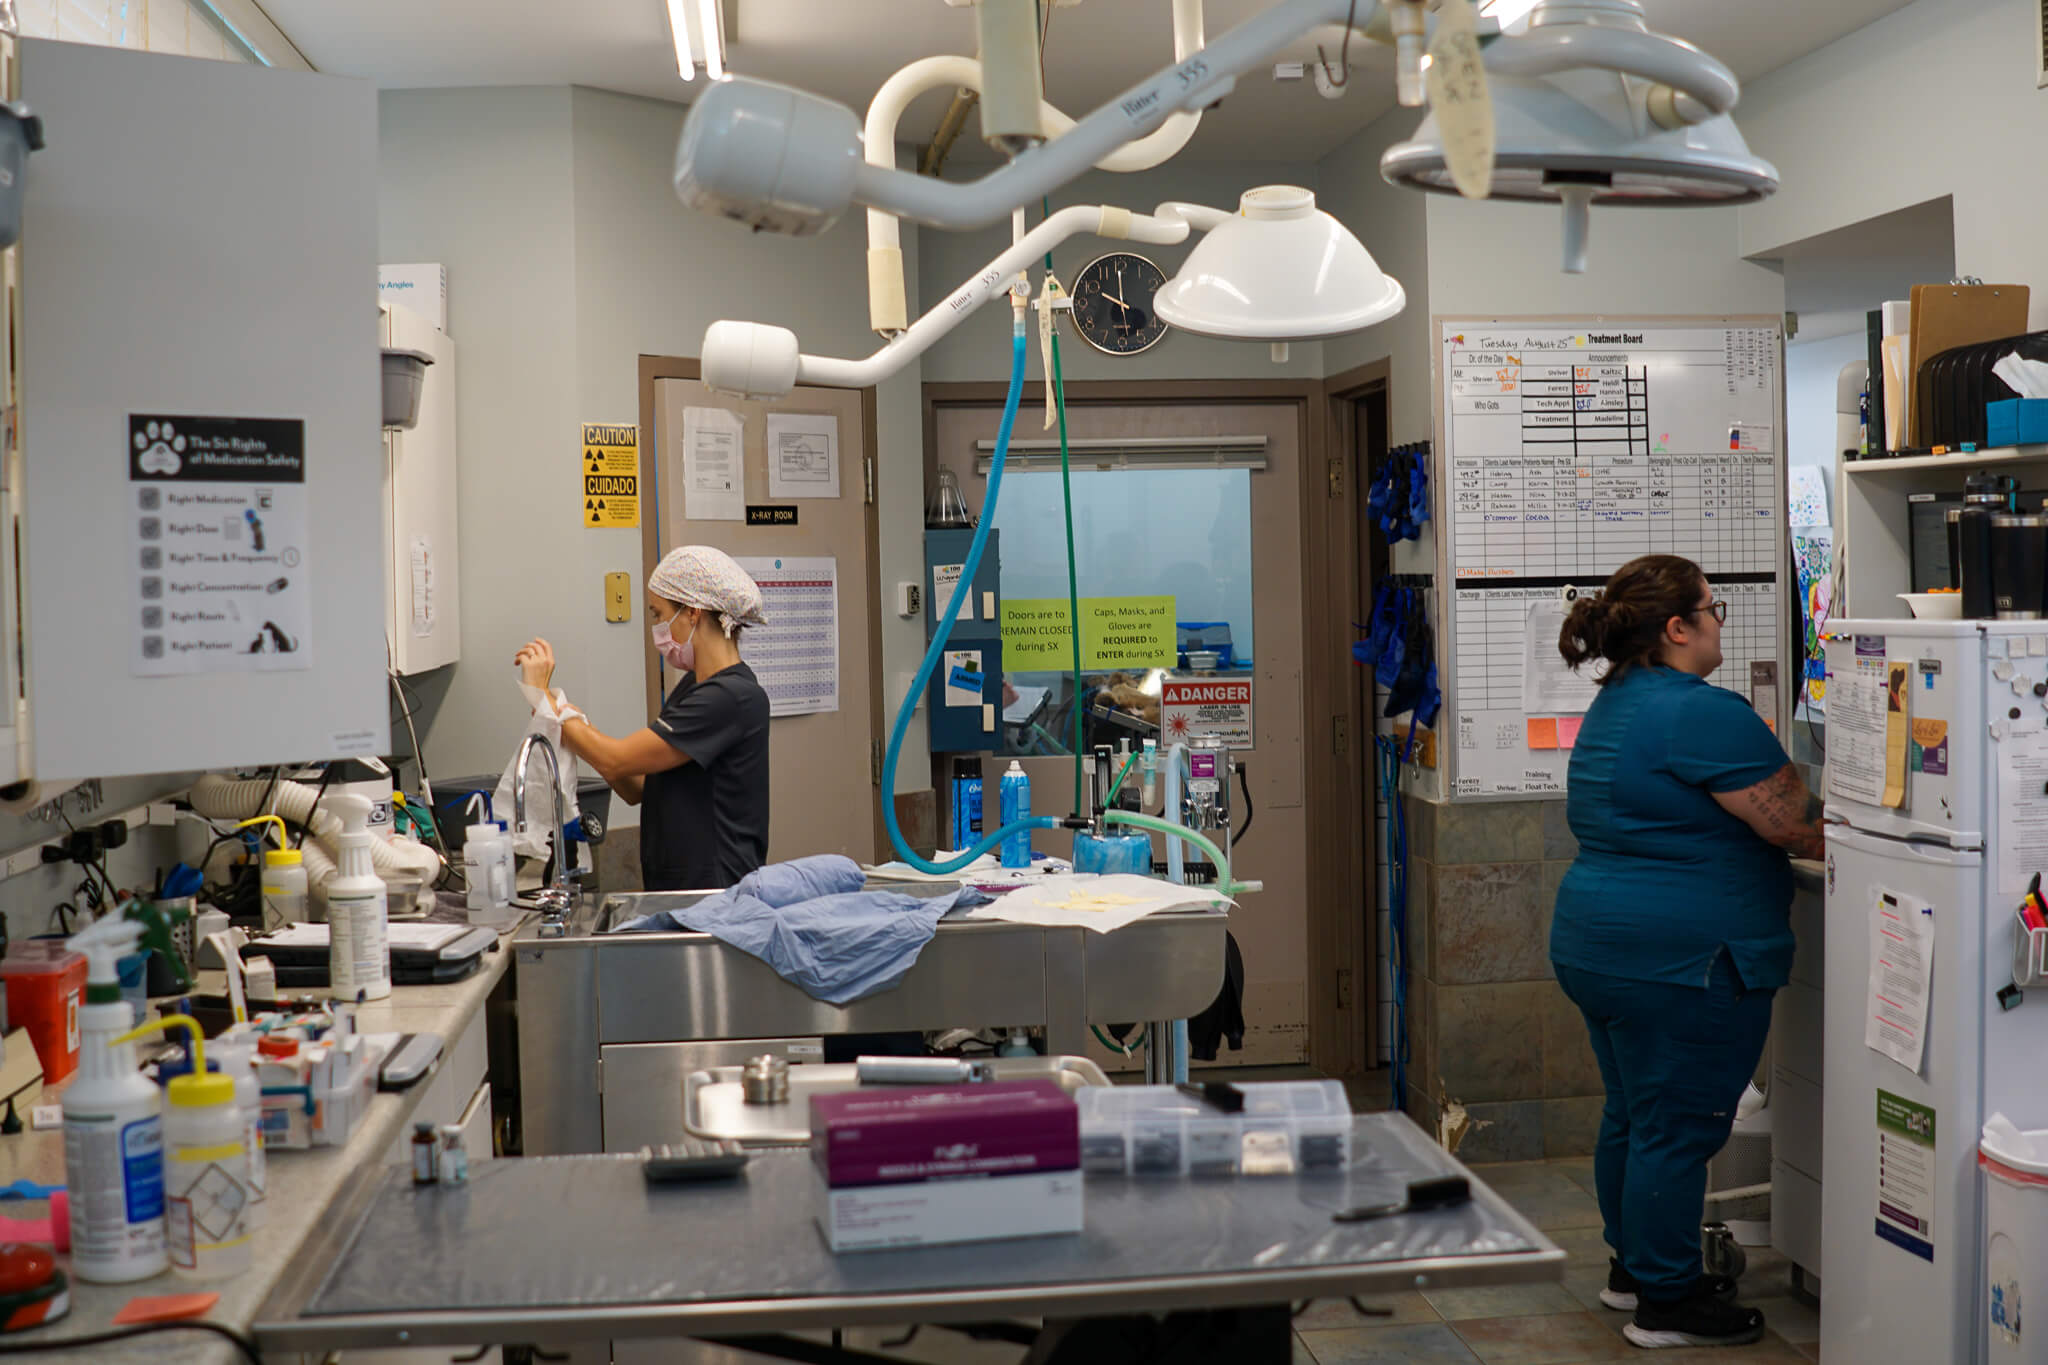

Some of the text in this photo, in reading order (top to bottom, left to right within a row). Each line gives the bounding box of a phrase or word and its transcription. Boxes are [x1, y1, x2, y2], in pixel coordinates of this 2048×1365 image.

[1099, 265, 1108, 280] 11
[387, 281, 414, 290] Angles
[1086, 280, 1100, 293] 10
[1078, 297, 1088, 310] 9
[1086, 317, 1095, 329] 8
[1137, 329, 1146, 344] 5
[1588, 334, 1643, 343] Treatment Board
[1480, 336, 1518, 350] Tuesday
[1524, 338, 1554, 349] August
[1477, 355, 1483, 363] of
[1484, 355, 1493, 363] the
[1494, 355, 1503, 364] Day
[1588, 354, 1628, 362] Announcements
[1475, 401, 1484, 409] Who
[587, 427, 634, 445] CAUTION
[189, 438, 267, 451] The Six Rights
[190, 454, 300, 469] of Medication Safety
[588, 478, 634, 494] CUIDADO
[168, 495, 247, 505] Right Medication
[751, 511, 793, 519] X-RAY ROOM
[168, 524, 194, 535] Right
[169, 554, 195, 564] Right
[231, 554, 279, 565] Frequency
[170, 582, 263, 593] Right Concentration
[1008, 610, 1036, 619] Doors
[1055, 611, 1065, 619] to
[1094, 606, 1165, 617] Caps, Masks, and
[171, 612, 196, 623] Right
[1039, 626, 1072, 635] CLOSED
[1108, 622, 1134, 631] Gloves
[1103, 635, 1158, 645] REQUIRED to
[172, 641, 233, 652] Right Patient
[1015, 641, 1059, 652] during SX
[1096, 649, 1165, 660] ENTER during SX
[1181, 687, 1248, 701] DANGER
[1525, 771, 1551, 779] Training
